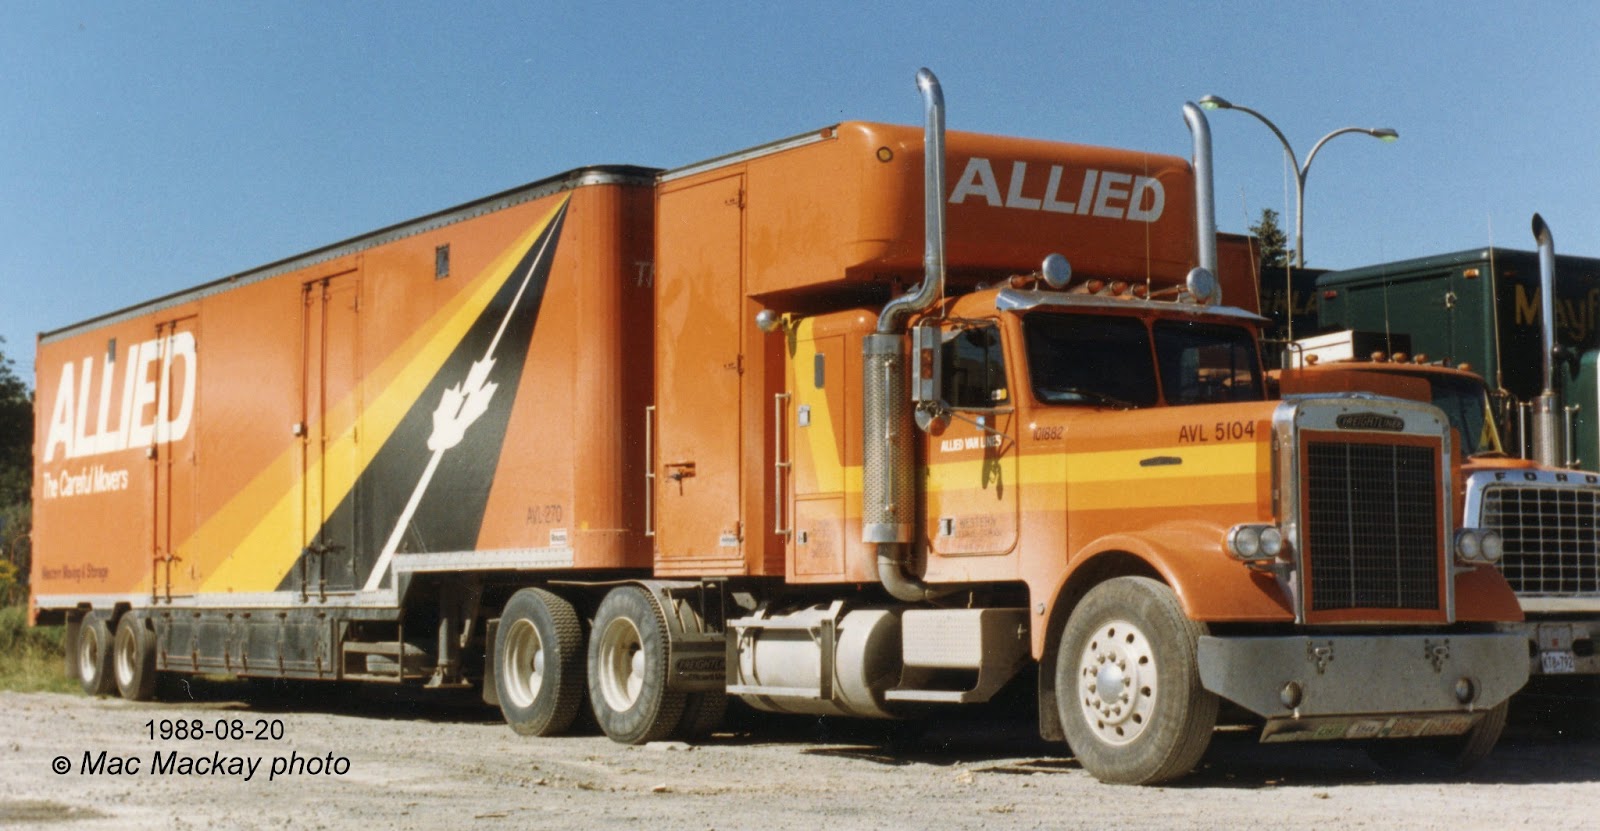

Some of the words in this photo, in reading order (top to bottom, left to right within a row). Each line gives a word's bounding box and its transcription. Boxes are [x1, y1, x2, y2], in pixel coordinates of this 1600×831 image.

[948, 157, 1165, 223] ALLIED
[43, 331, 197, 464] ALLIED
[1178, 424, 1208, 443] AVL
[1215, 421, 1255, 440] 5104
[1342, 416, 1403, 429] FREIGHTLINER
[940, 438, 964, 453] ALLIED
[965, 436, 979, 450] VAN
[980, 434, 1002, 448] LINES
[1032, 426, 1064, 441] 101882
[43, 471, 58, 500] The
[60, 465, 93, 498] Careful
[94, 465, 128, 494] Movers
[1494, 471, 1598, 484] FORD
